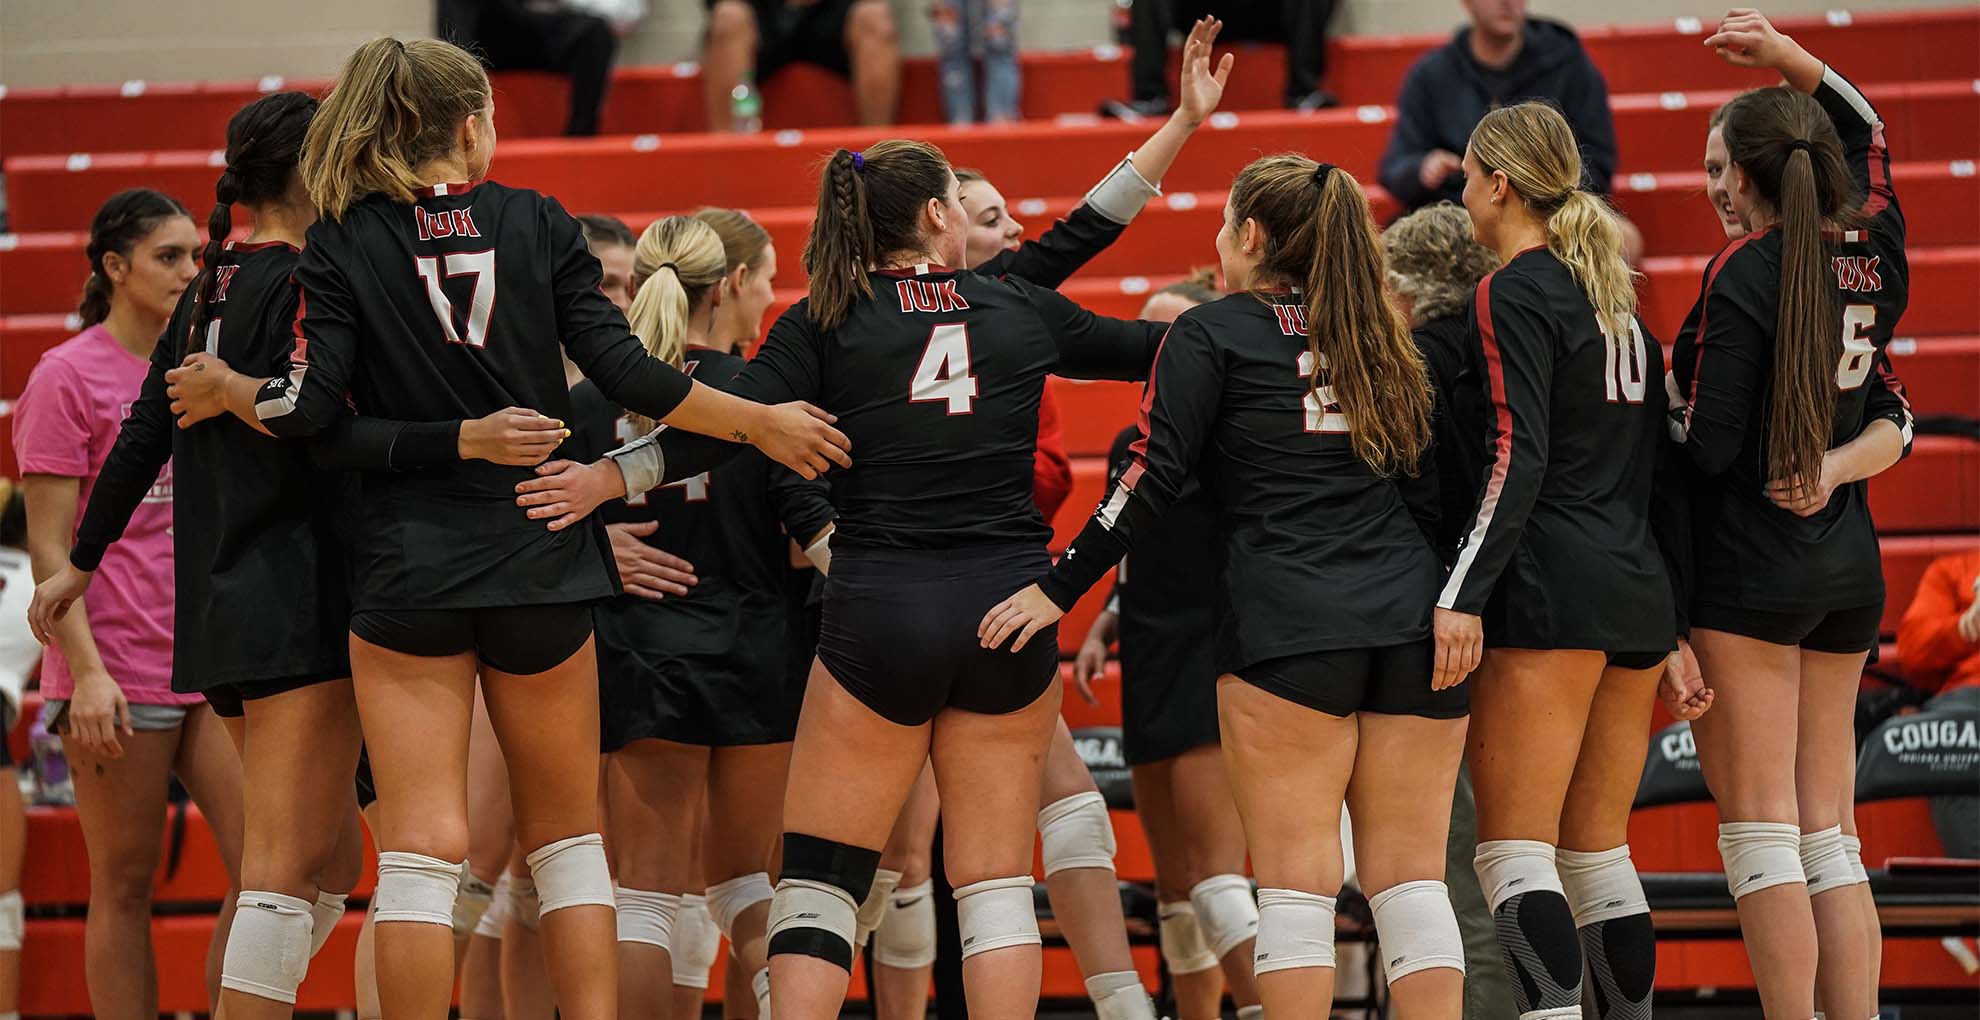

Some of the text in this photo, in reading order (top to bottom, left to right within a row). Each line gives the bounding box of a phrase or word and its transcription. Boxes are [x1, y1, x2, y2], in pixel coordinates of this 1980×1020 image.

[414, 204, 482, 241] IUK
[413, 248, 497, 349] 17
[896, 279, 970, 313] IUK
[1273, 304, 1312, 336] IU
[909, 321, 979, 416] 4
[1595, 312, 1648, 404] 10
[1836, 304, 1878, 391] 6
[1296, 350, 1352, 433] 2
[1884, 720, 1980, 754] COUGA
